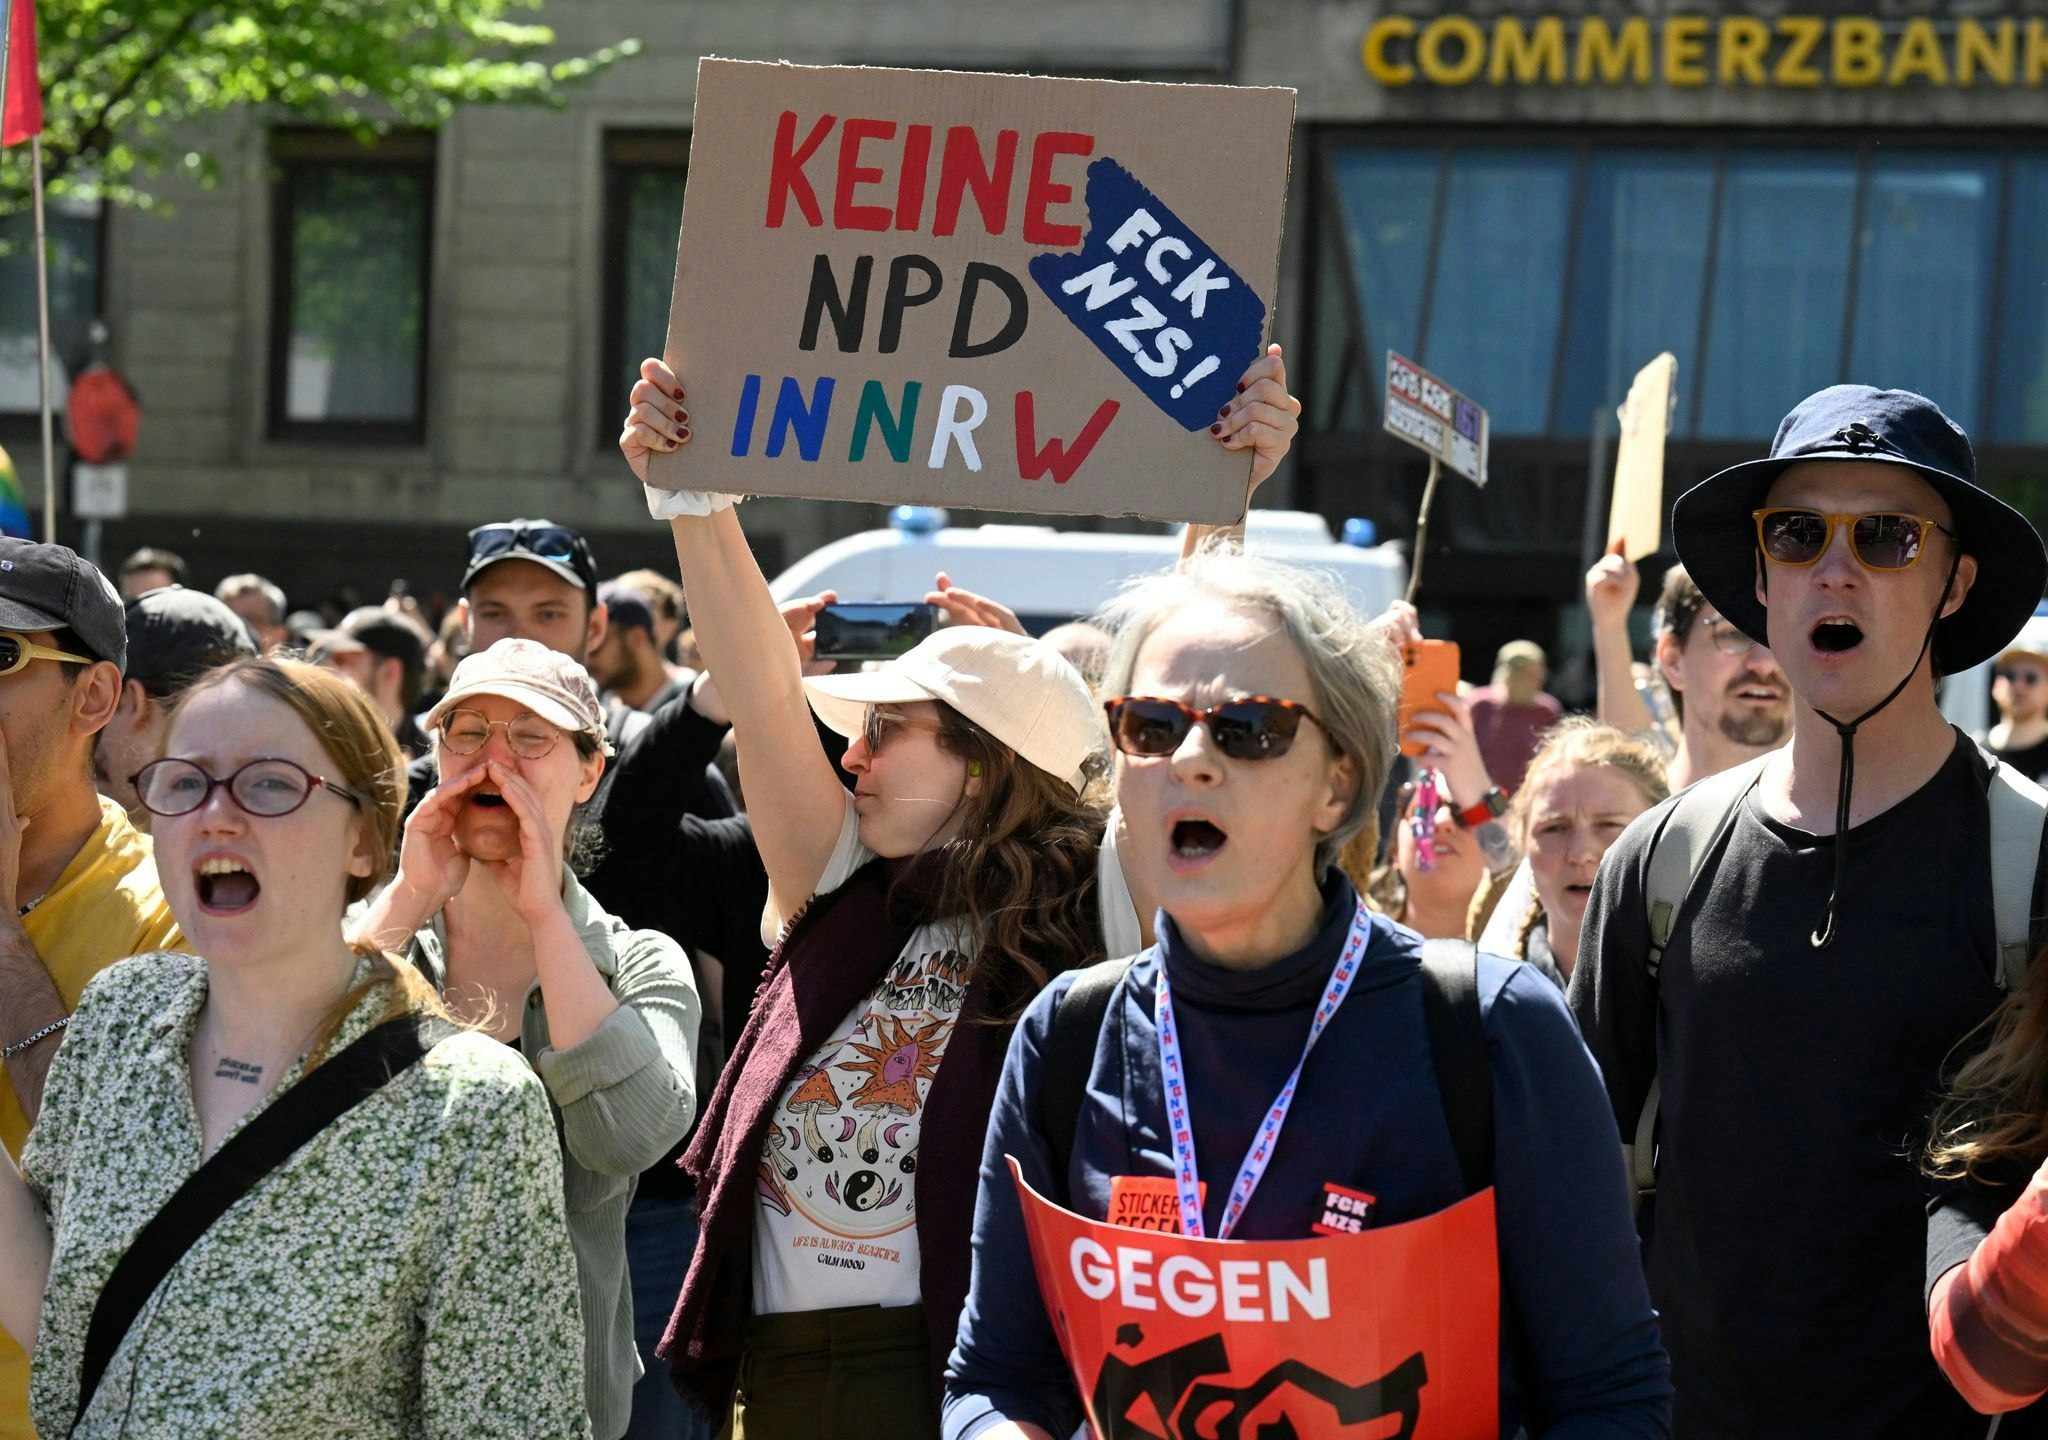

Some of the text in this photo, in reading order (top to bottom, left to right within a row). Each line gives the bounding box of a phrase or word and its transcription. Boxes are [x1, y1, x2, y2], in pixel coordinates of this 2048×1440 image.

[765, 110, 1095, 247] KEINE
[798, 254, 1029, 358] NPD
[1106, 207, 1231, 319] FCK
[1061, 260, 1221, 399] NZS!
[731, 374, 1121, 484] IN NRW
[792, 1235, 901, 1264] LIFE IS ALWAYS BEAUTIFUL
[1321, 1210, 1362, 1235] NZS
[1325, 1191, 1369, 1217] FCK
[817, 1253, 866, 1271] CALM MOOD
[1069, 1236, 1331, 1322] GEGEN
